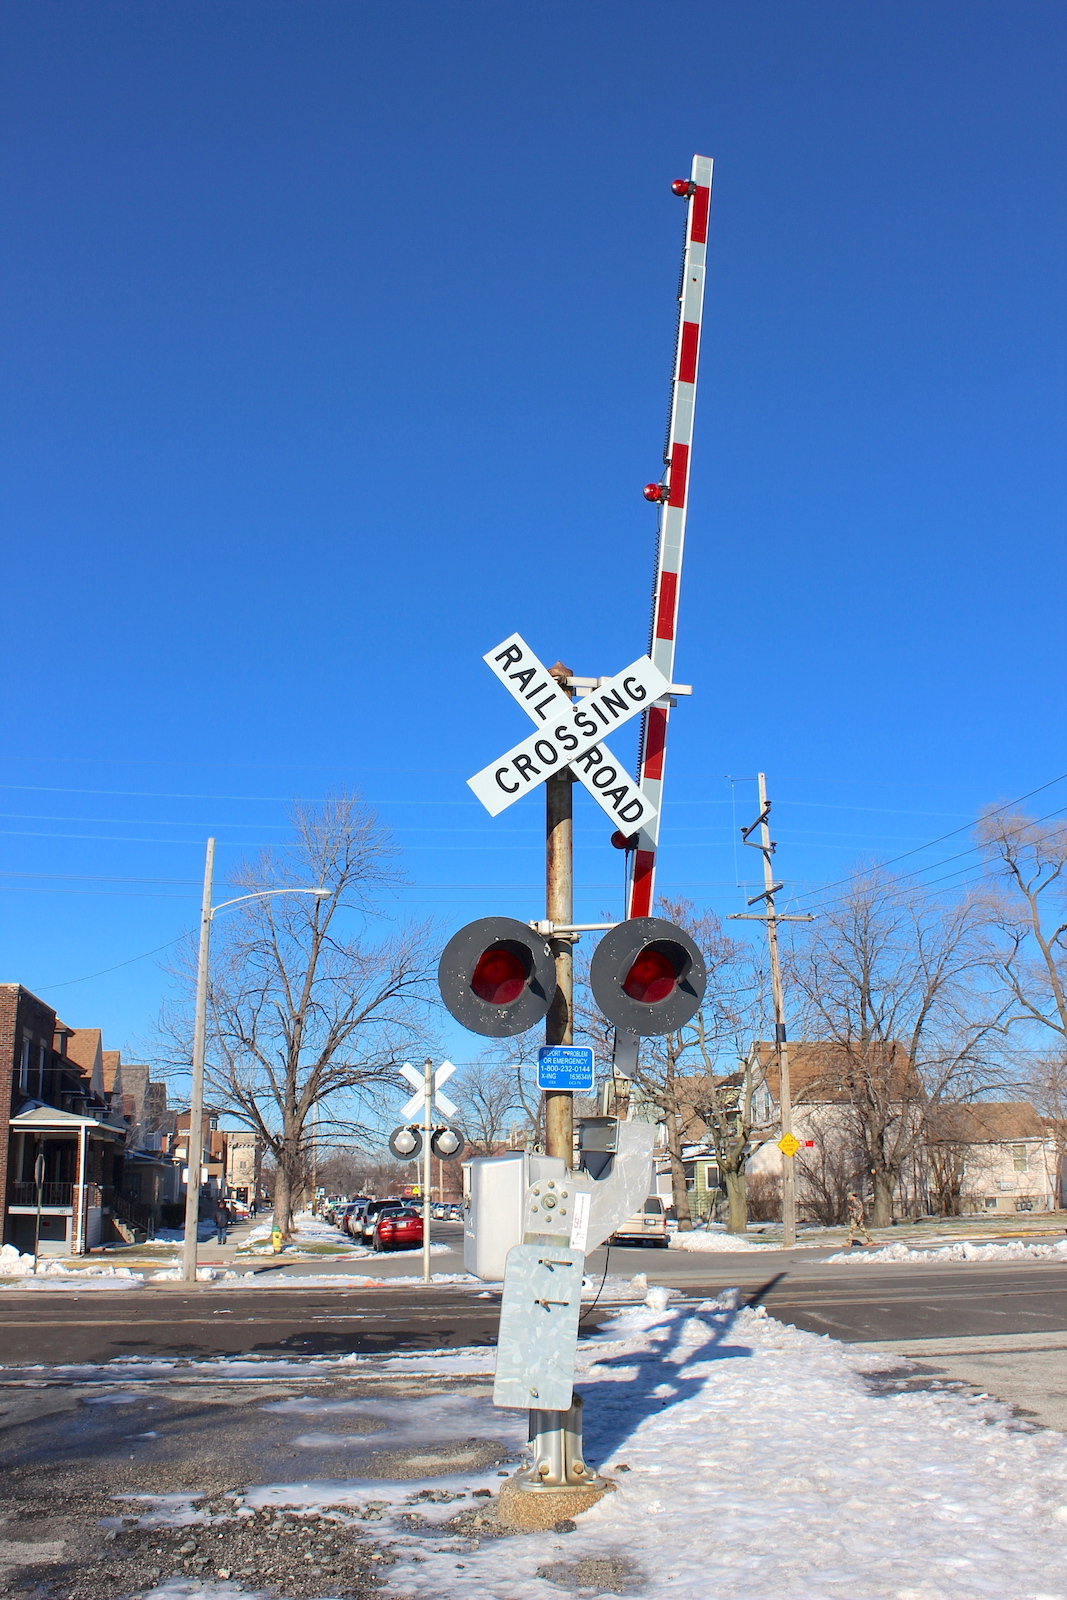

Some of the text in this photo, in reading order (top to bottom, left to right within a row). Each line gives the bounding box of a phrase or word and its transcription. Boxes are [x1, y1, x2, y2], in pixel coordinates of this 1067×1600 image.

[494, 643, 644, 823] RAIL ROAD
[495, 676, 647, 794] CROSSING
